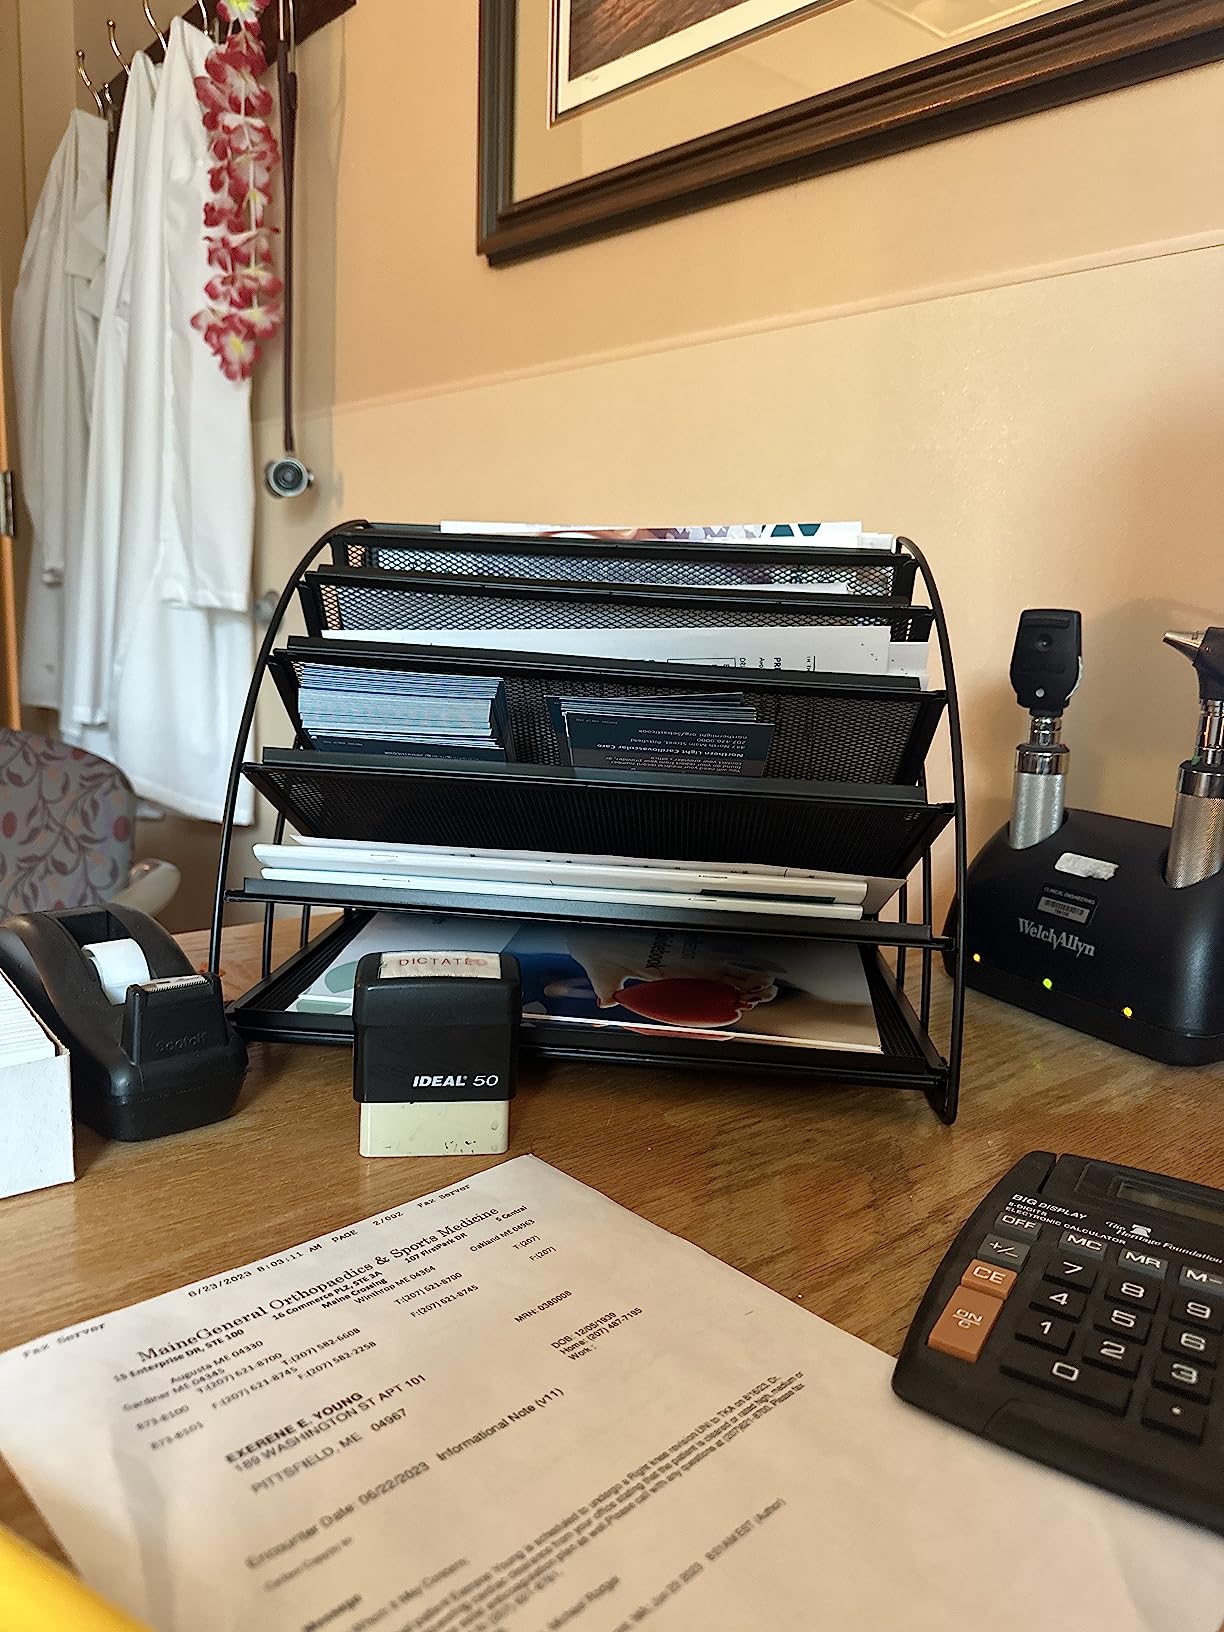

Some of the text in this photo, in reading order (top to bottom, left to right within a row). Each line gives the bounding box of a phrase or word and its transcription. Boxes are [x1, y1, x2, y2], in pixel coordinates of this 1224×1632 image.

[618, 745, 680, 753] Cardiovascular
[472, 1074, 499, 1087] 50
[1012, 1193, 1088, 1220] BIG DISPLAY
[308, 1243, 323, 1253] AM
[331, 1229, 358, 1243] PAGE
[438, 1184, 471, 1200] Server
[1002, 1214, 1037, 1230] OFF
[1005, 1206, 1127, 1245] ELECTRONIC CALCULATOR
[404, 1253, 420, 1263] 107
[455, 1232, 468, 1241] DR
[469, 1234, 501, 1252] Oakland
[1066, 1234, 1103, 1251] MC
[1116, 1229, 1223, 1264] Heritage Foundation
[1063, 1261, 1084, 1275] 7
[1125, 1251, 1161, 1269] MR
[136, 1208, 499, 1362] MaineGeneral Orthopaedics & Sports Medicine
[972, 1265, 1006, 1284] CE
[285, 1291, 334, 1315] Commerce
[353, 1276, 369, 1287] STE
[321, 1278, 388, 1309] Maine Crossing
[354, 1284, 396, 1304] Winthrop
[395, 1276, 410, 1288] ME
[1049, 1292, 1068, 1306] 4
[1120, 1282, 1145, 1298] 8
[956, 1308, 983, 1324] ON
[1110, 1309, 1136, 1328] 5
[1186, 1301, 1211, 1319] 9
[1040, 1320, 1052, 1335] 1
[1100, 1340, 1125, 1360] 2
[1180, 1332, 1206, 1352] 6
[129, 1354, 184, 1379] Enterprise
[205, 1337, 225, 1349] STE
[225, 1328, 245, 1341] 100
[170, 1362, 213, 1384] Augusta
[1052, 1361, 1080, 1382] 0
[1171, 1363, 1198, 1385] 3
[261, 1407, 358, 1460] WASHINGTON
[358, 1398, 377, 1412] ST
[378, 1384, 404, 1402] APT
[404, 1374, 427, 1389] 101
[339, 1432, 364, 1448] ME
[370, 1407, 409, 1432] 04967
[436, 1387, 565, 1461] Informational Note (v11)
[225, 1424, 297, 1464] EXERENE
[312, 1392, 364, 1420] YOUNG
